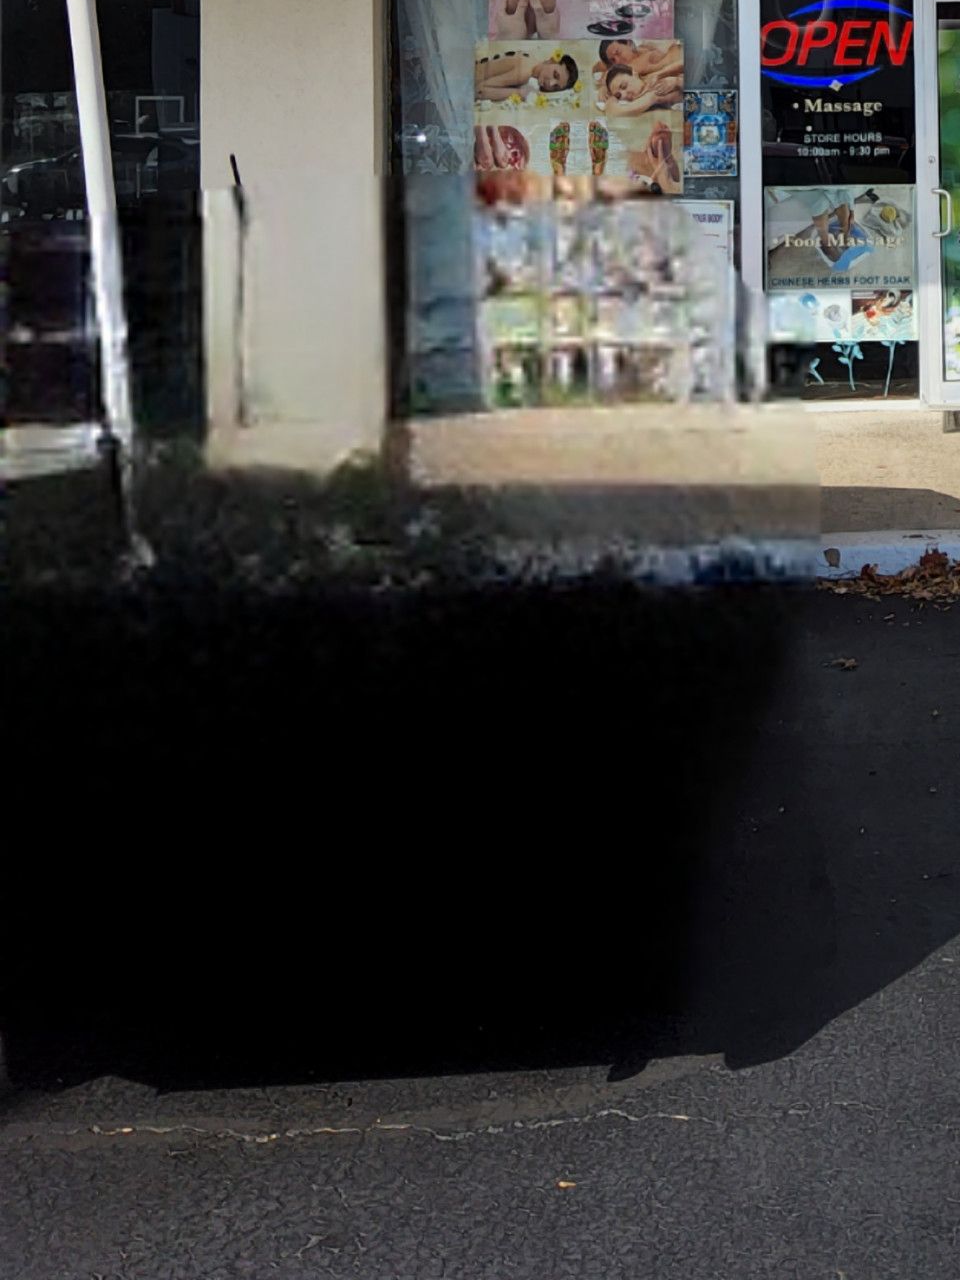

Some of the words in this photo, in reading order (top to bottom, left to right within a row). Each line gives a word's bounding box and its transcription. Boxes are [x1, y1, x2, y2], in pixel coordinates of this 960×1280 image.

[760, 19, 914, 66] OPEN
[804, 98, 883, 117] Massage
[843, 132, 883, 143] HOURS
